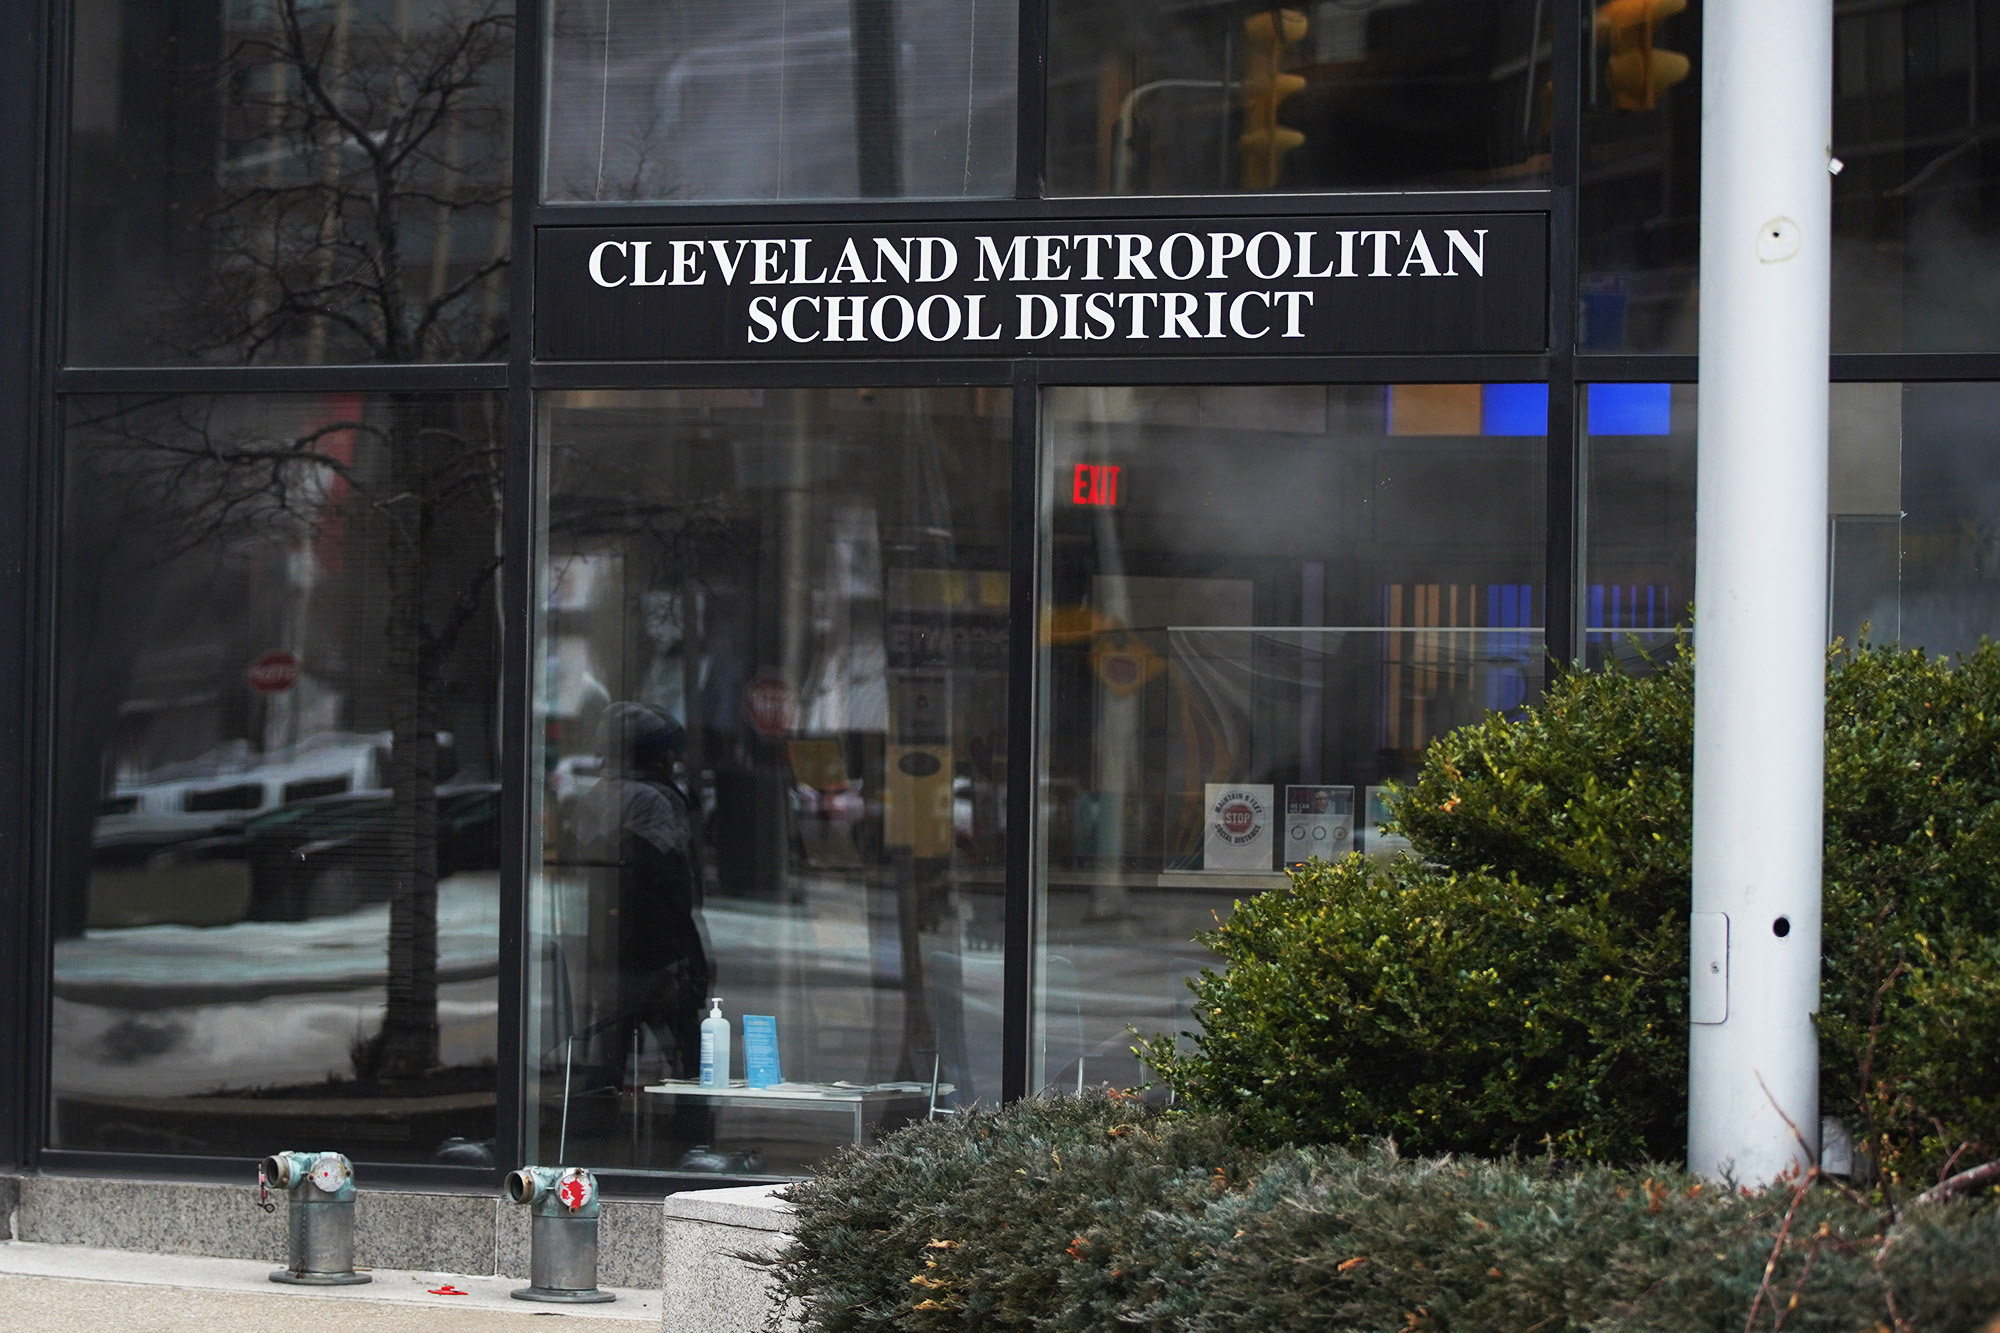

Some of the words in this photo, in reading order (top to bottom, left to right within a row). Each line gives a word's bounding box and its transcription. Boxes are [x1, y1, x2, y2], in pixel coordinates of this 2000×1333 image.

[588, 236, 958, 287] CLEVELAND
[974, 229, 1489, 281] METROPOLITAN
[748, 295, 1002, 343] SCHOOL
[1014, 291, 1314, 339] DISTRICT
[1073, 463, 1120, 506] EXIT
[1215, 793, 1244, 813] MAINTAIN
[1250, 799, 1262, 814] FEET
[1226, 812, 1251, 824] STOP
[1215, 824, 1232, 844] SOCIAL
[1234, 823, 1261, 844] DISTANCE
